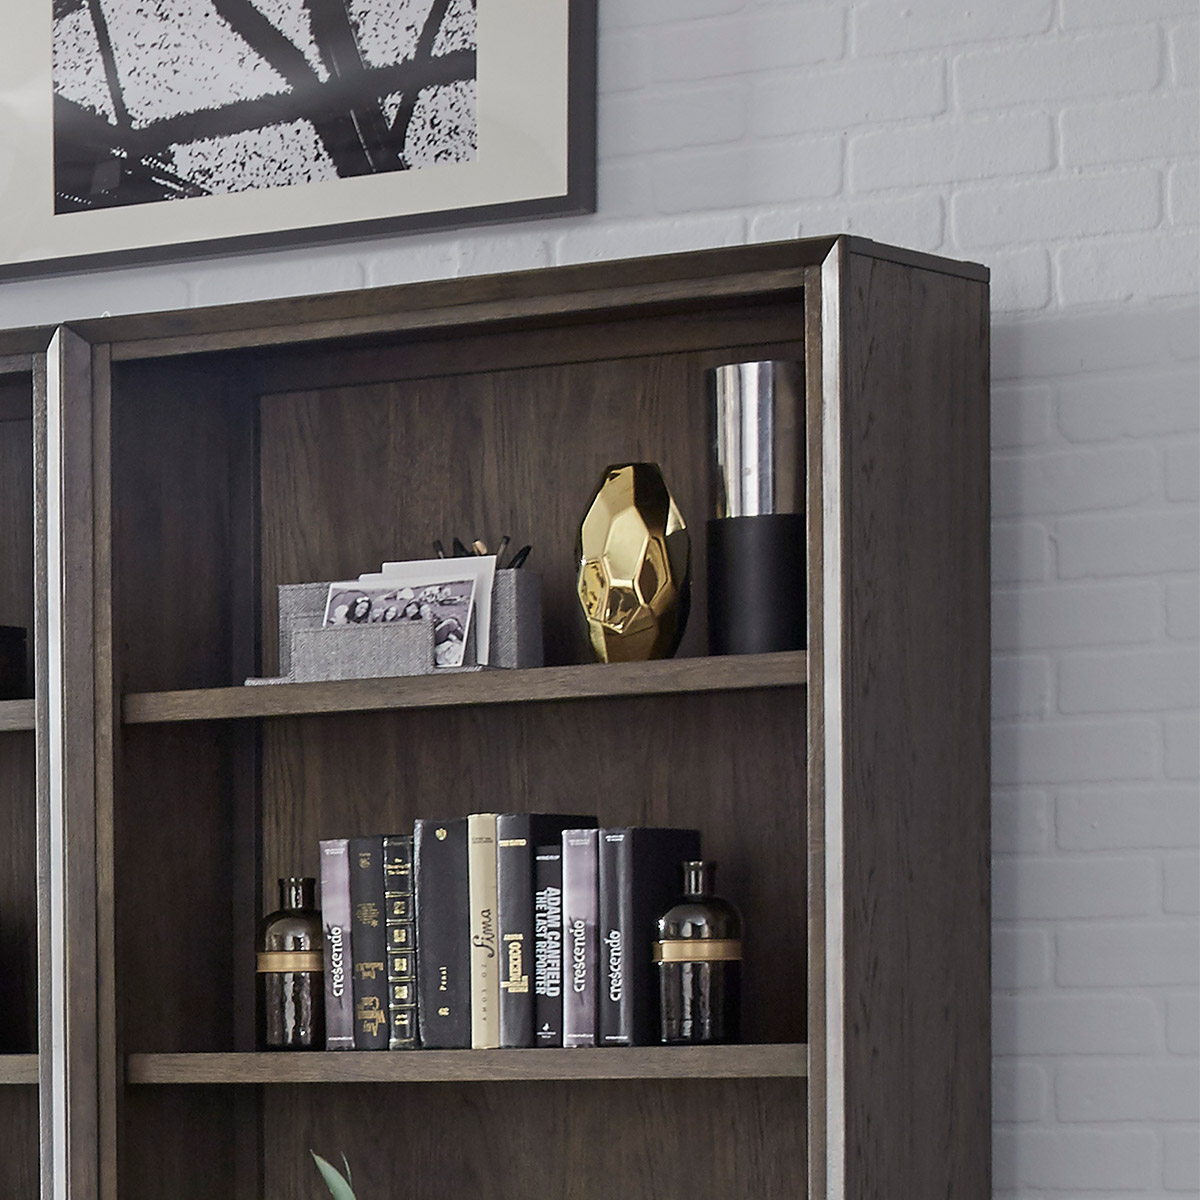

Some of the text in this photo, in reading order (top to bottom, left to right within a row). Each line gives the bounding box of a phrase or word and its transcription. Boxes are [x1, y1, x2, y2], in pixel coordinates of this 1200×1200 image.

[327, 926, 345, 997] crescendo
[536, 891, 547, 995] THE LAST REPORTER
[546, 886, 561, 997] ADAM CANFIELD
[569, 919, 586, 993] crescendo
[604, 930, 622, 1002] crescendo
